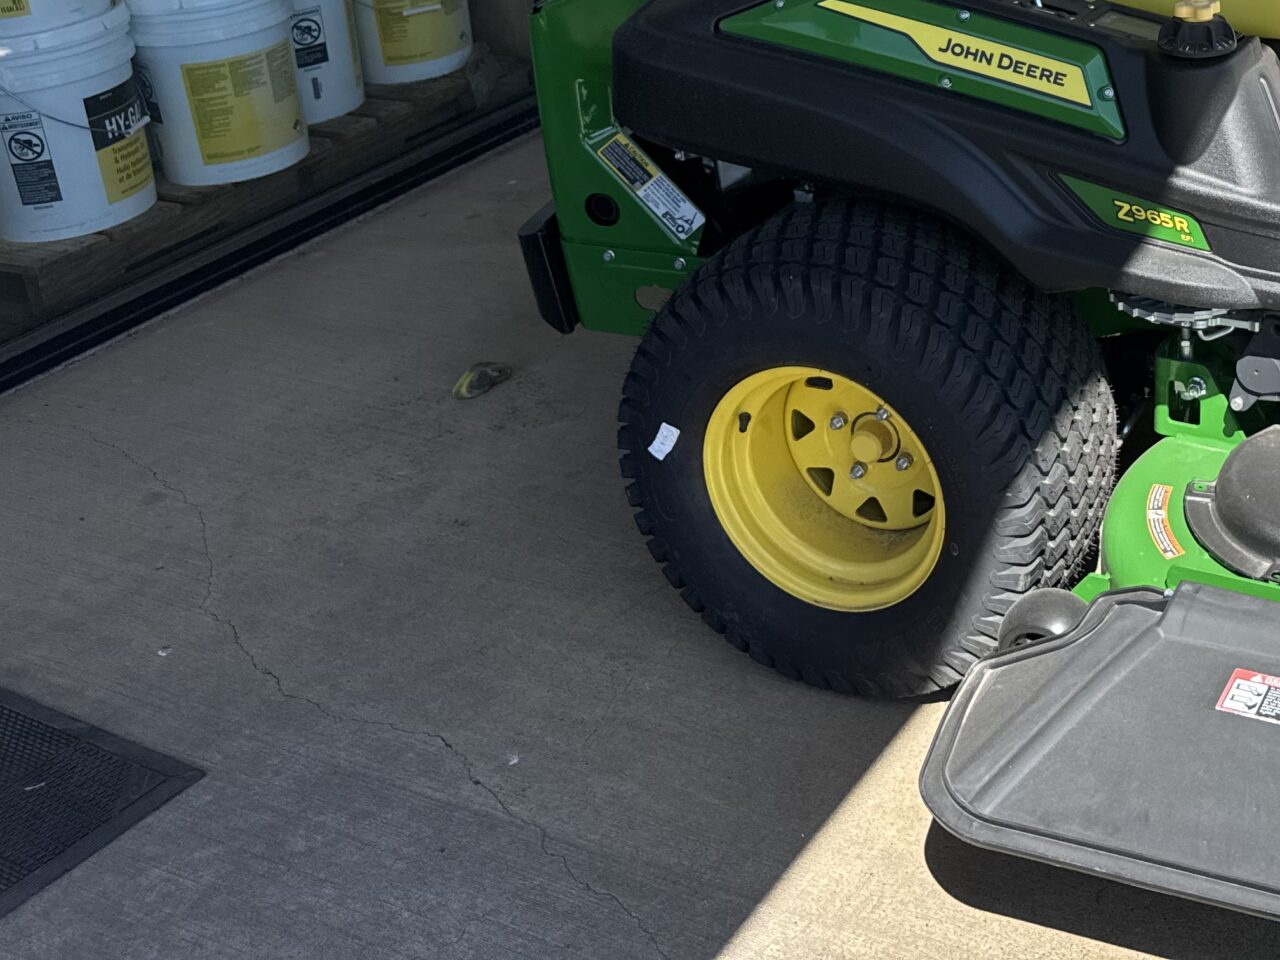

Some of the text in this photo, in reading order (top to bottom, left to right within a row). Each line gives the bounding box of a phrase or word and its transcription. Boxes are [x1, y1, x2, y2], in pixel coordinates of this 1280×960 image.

[938, 38, 1067, 87] JOHN DEERE
[1113, 199, 1190, 234] Z965R
